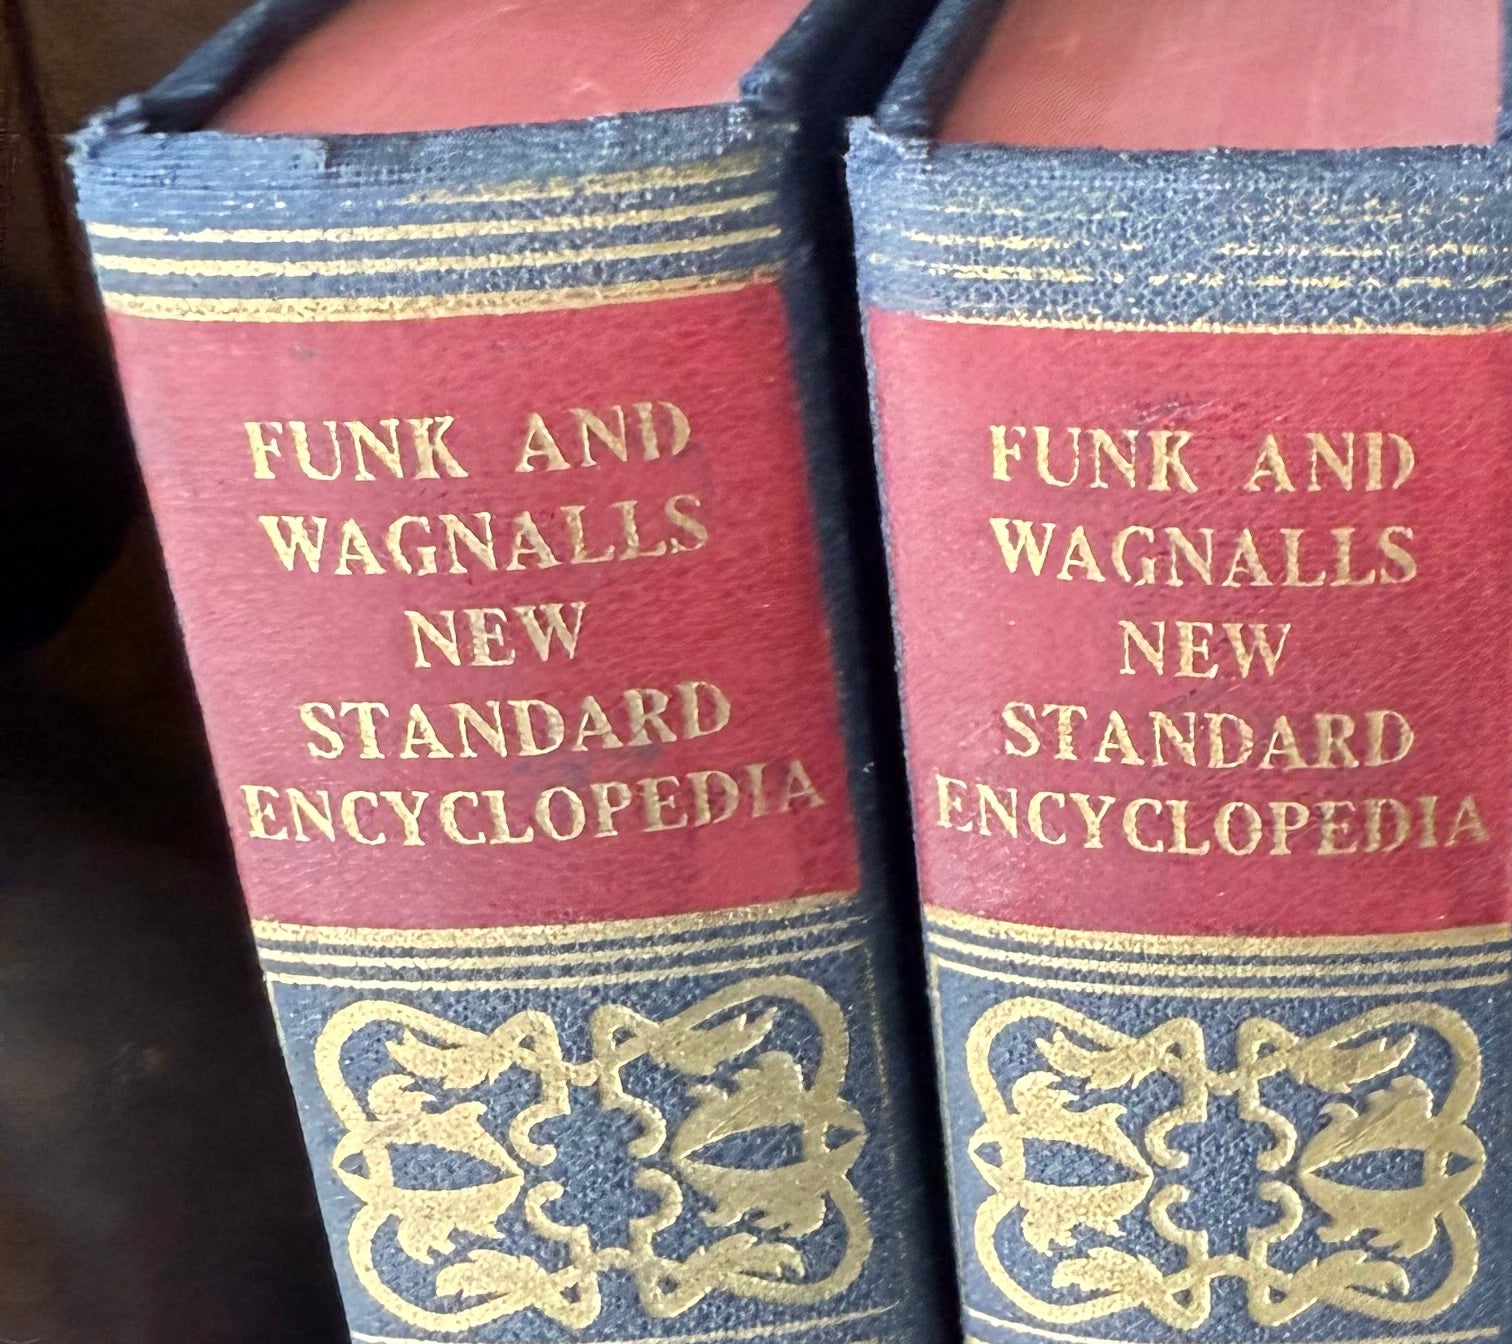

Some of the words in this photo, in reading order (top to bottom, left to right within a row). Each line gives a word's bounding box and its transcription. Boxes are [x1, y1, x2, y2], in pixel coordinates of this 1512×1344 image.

[244, 415, 468, 481] FUNK
[515, 401, 692, 473] AND
[989, 425, 1198, 492] FUNK
[1243, 432, 1416, 493] AND
[258, 494, 709, 576] WAGNALLS
[989, 517, 1418, 588] WAGNALLS
[403, 601, 590, 669] NEW
[1118, 620, 1291, 679] NEW
[299, 681, 732, 761] STANDARD
[1000, 701, 1416, 770] STANDARD
[240, 759, 825, 846] ENCYCLOPEDIA
[934, 773, 1491, 856] ENCYCLOPEDIA
